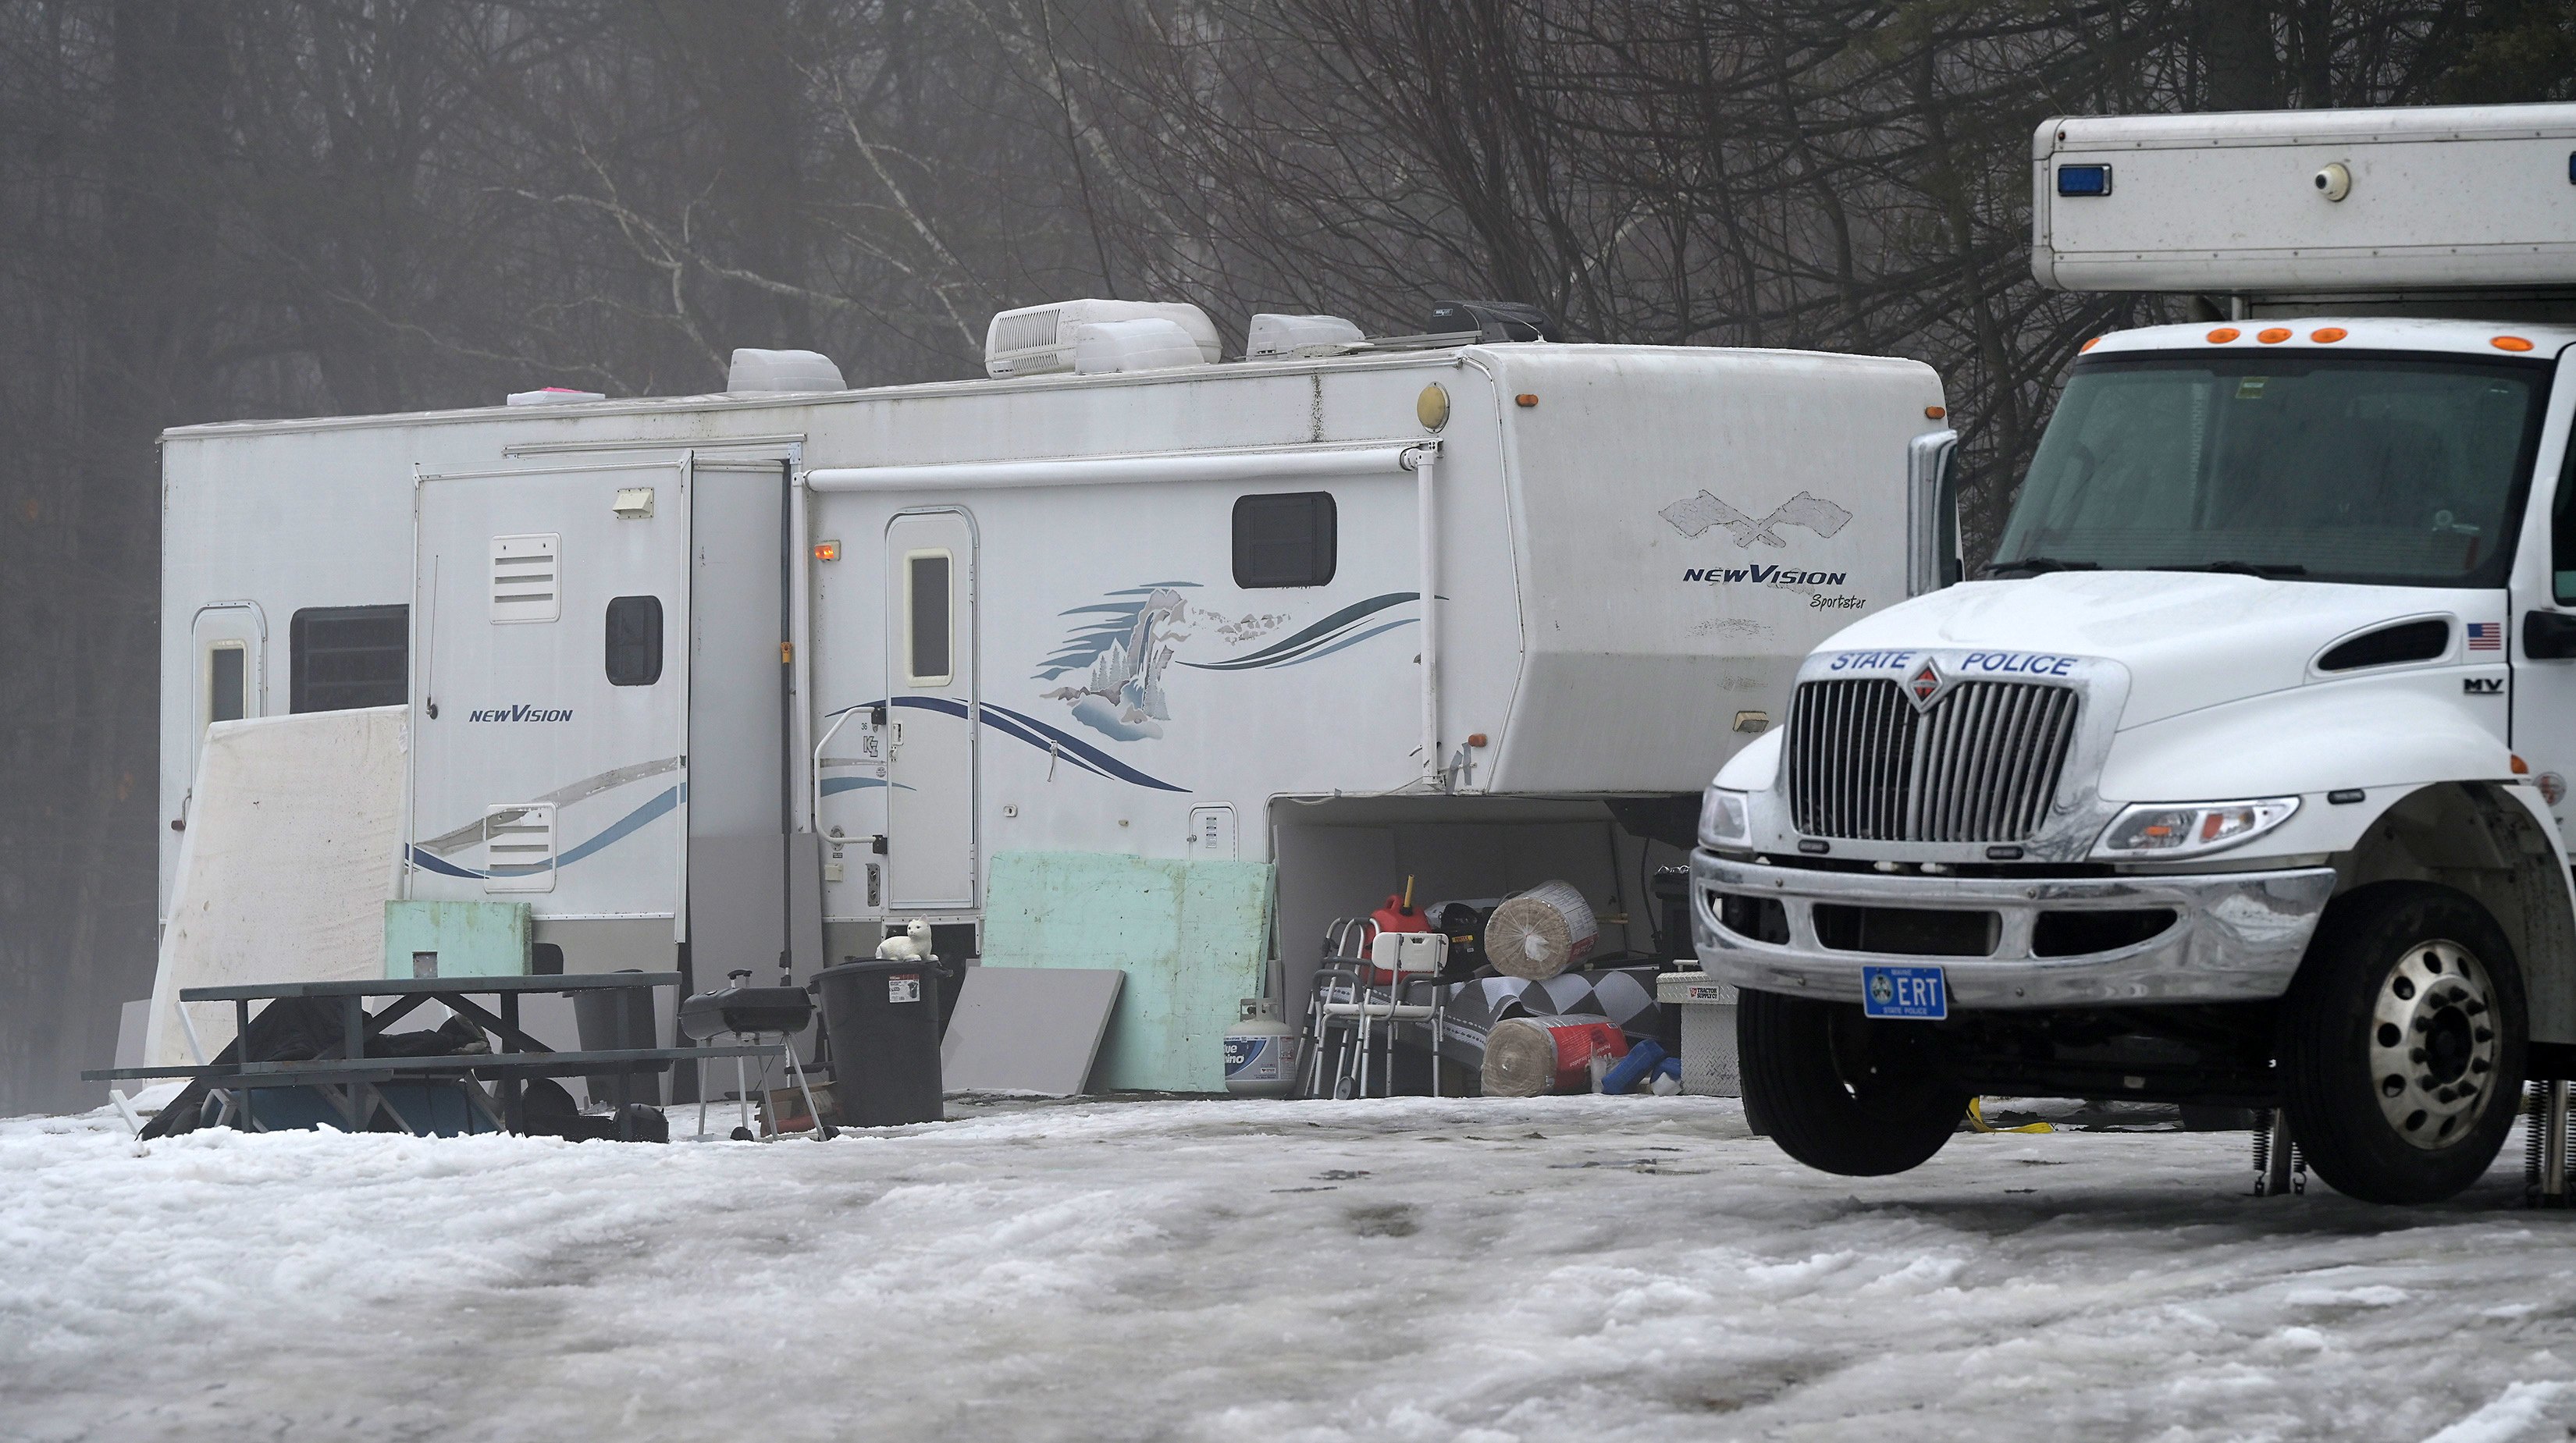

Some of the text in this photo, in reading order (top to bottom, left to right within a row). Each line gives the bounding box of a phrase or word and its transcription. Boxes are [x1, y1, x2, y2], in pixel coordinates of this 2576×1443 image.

[1810, 594, 1866, 612] Sportster
[1831, 651, 2078, 677] STATE POLICE
[2464, 678, 2503, 691] MV
[861, 722, 868, 730] 36
[1897, 978, 1937, 1006] ERT
[1224, 1044, 1237, 1054] lue
